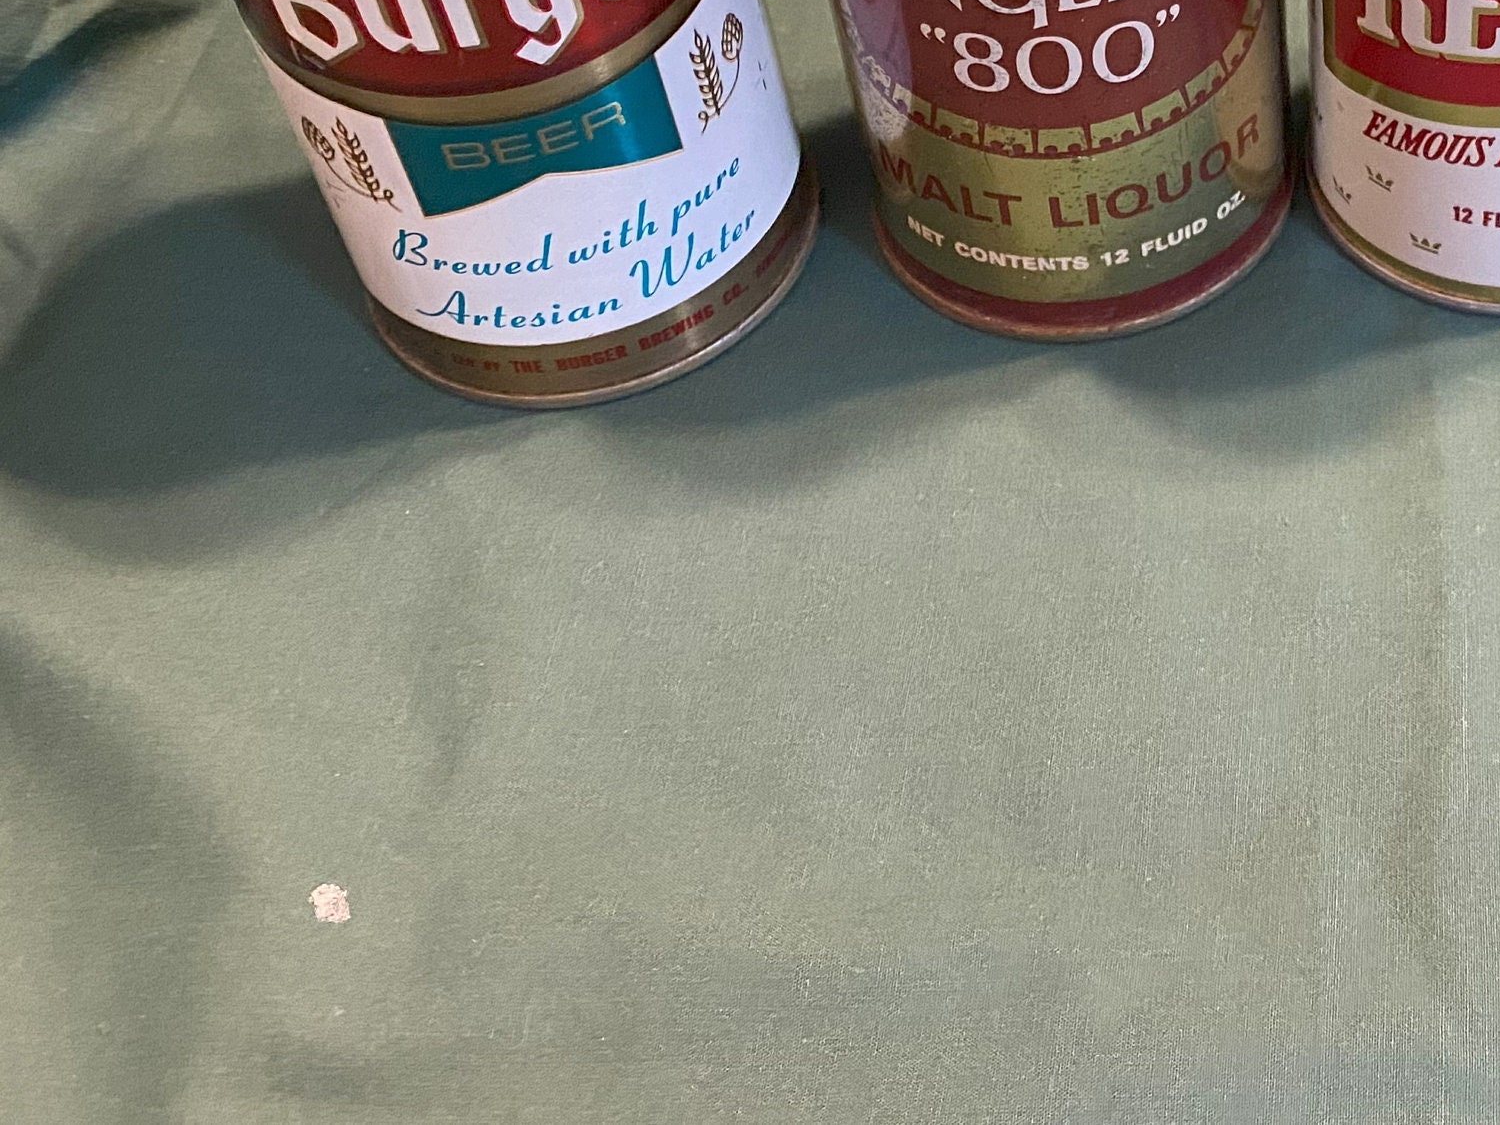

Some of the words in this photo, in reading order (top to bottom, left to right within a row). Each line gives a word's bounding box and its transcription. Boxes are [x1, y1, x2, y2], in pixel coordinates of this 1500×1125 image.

[440, 101, 628, 171] BEER
[1362, 110, 1494, 168] FAMOUS
[877, 139, 1023, 226] MALT
[1048, 113, 1260, 229] LIQUOR
[391, 228, 553, 277] Brewed
[568, 200, 659, 264] with
[671, 155, 742, 238] pure
[906, 213, 947, 248] NET
[954, 239, 1090, 272] CONTENTS
[1100, 248, 1131, 267] 12
[1141, 216, 1208, 259] FLUID
[1452, 205, 1474, 226] 12
[415, 290, 622, 329] Artesian
[629, 208, 757, 298] Water
[507, 359, 543, 374] THE
[555, 344, 628, 372] BURGER
[637, 305, 716, 352] BREWING
